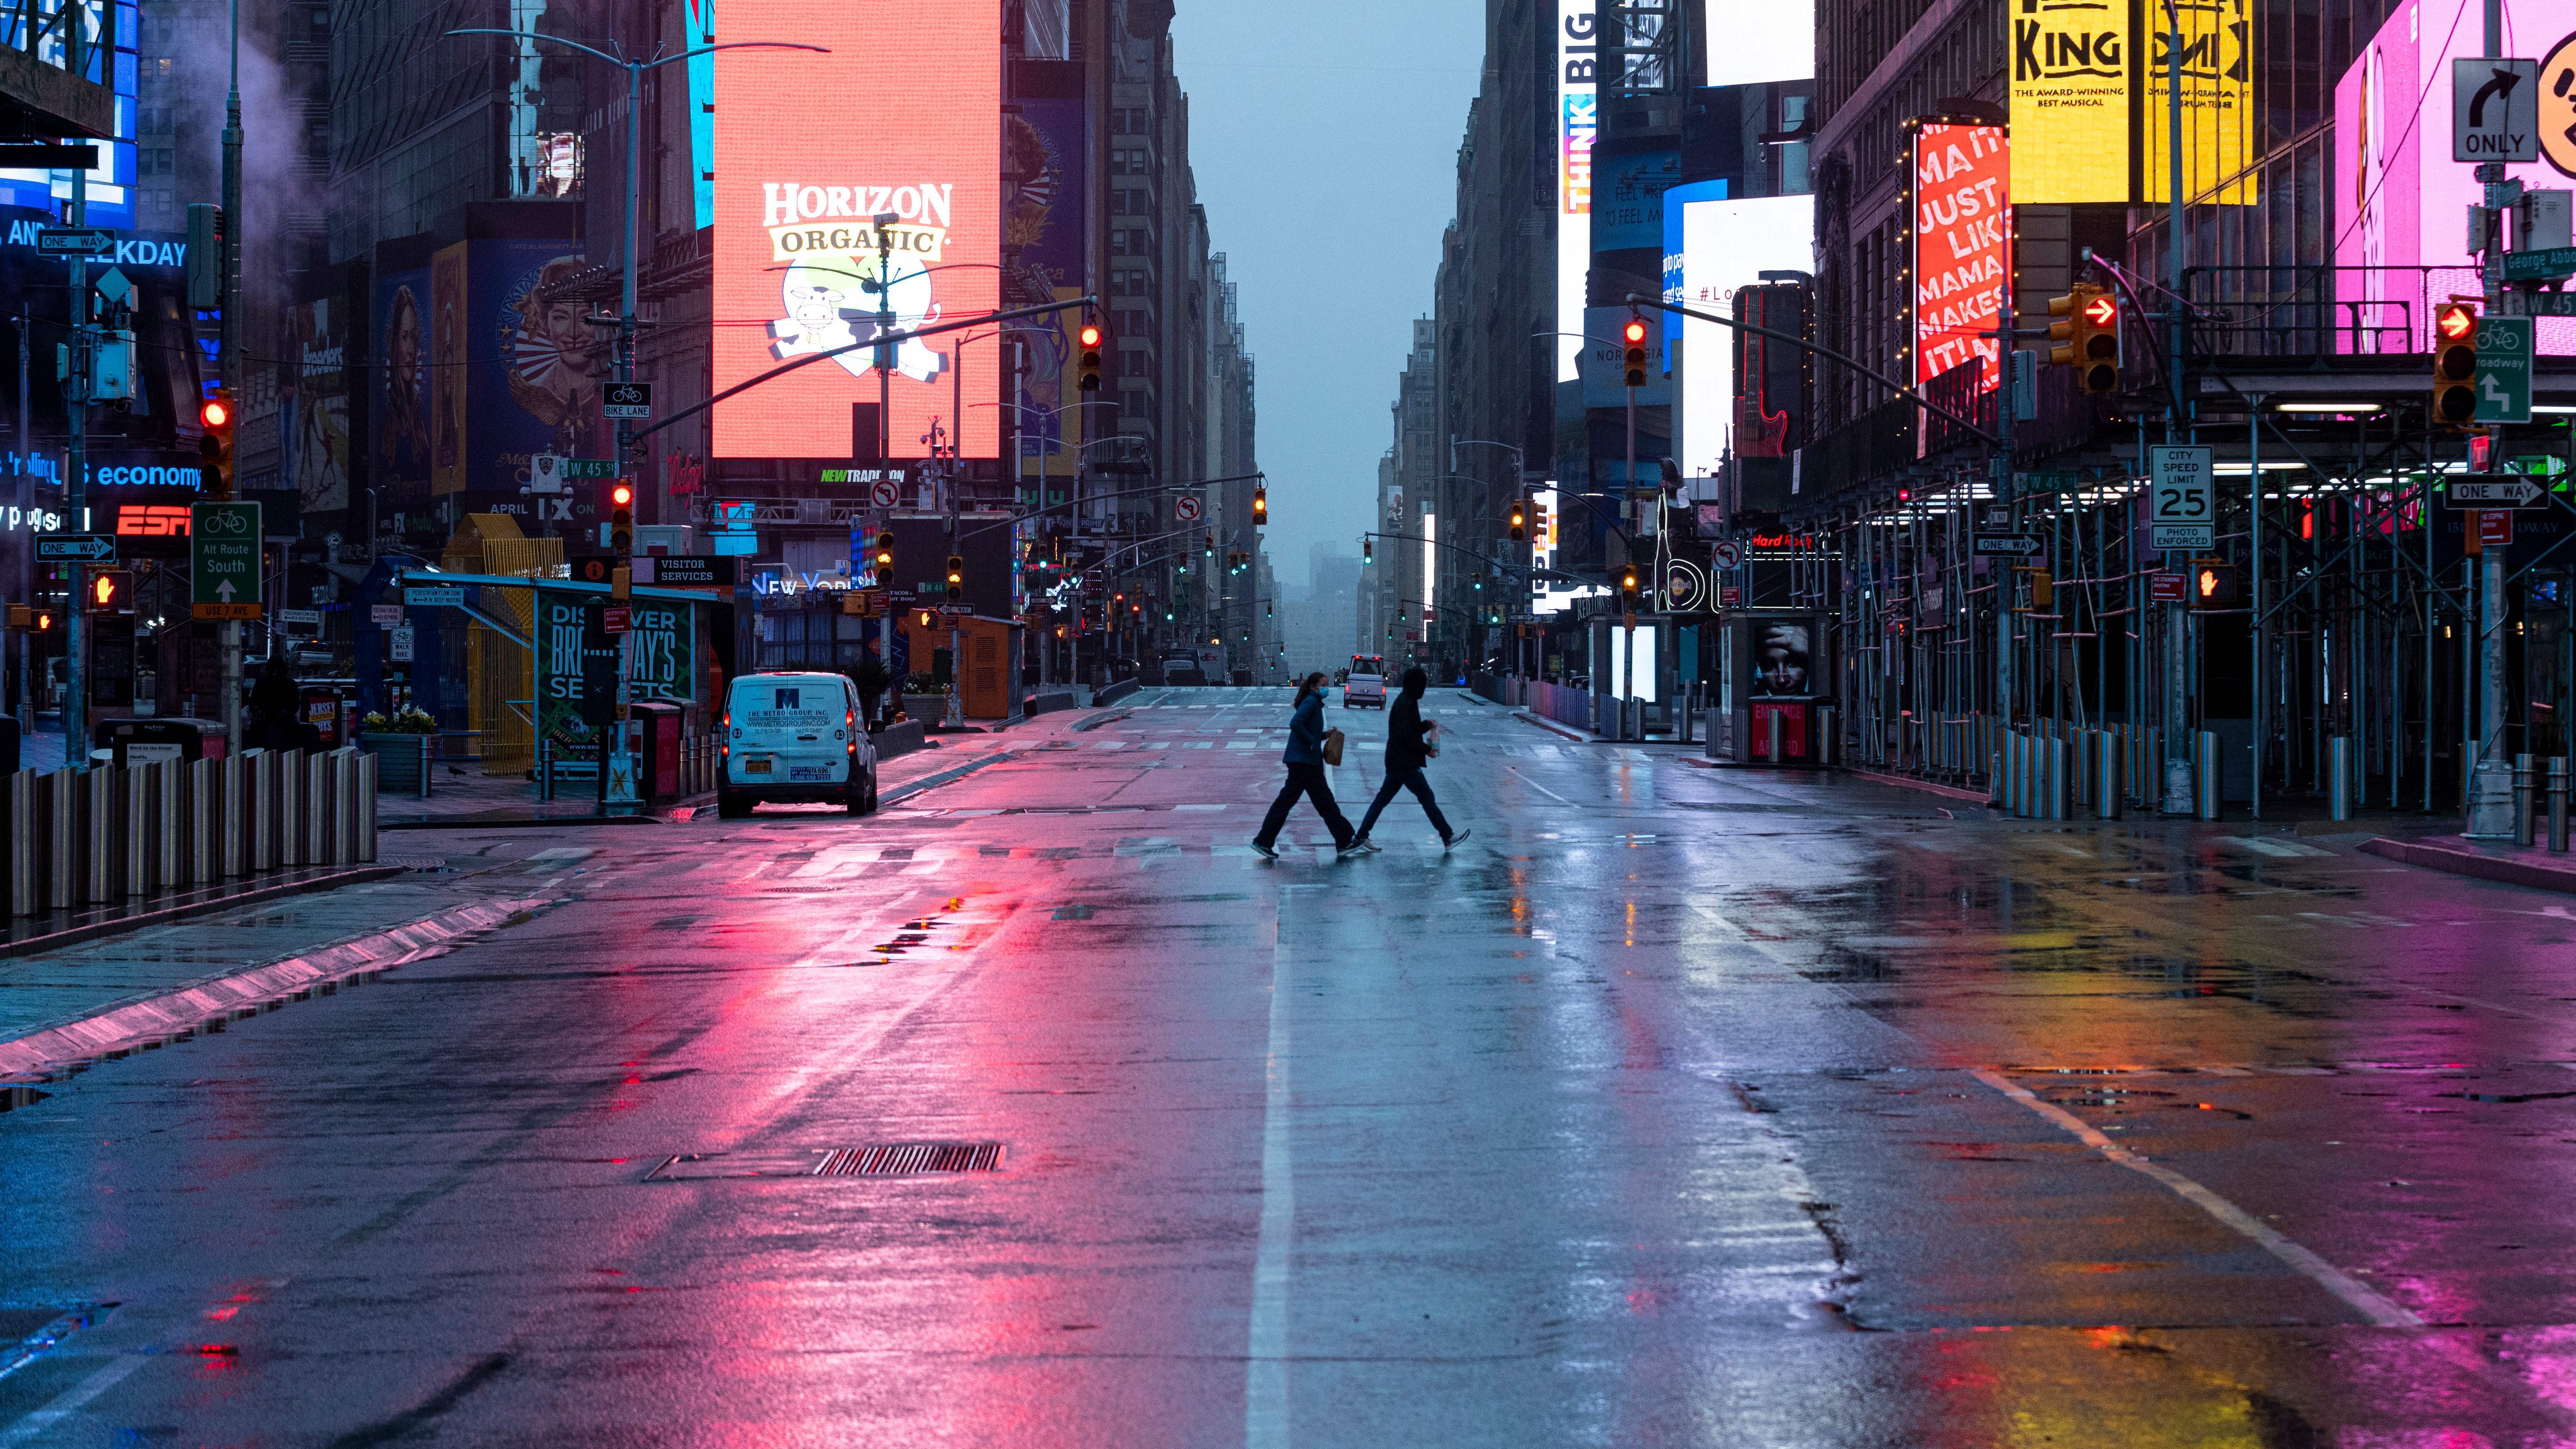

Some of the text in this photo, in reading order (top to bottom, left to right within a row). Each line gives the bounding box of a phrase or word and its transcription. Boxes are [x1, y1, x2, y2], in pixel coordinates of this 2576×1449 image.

[2015, 18, 2121, 82] KING
[2036, 88, 2123, 96] AWARD-WINNING
[1549, 53, 1557, 175] SQUARE
[1565, 13, 1596, 210] THINK BIG
[2466, 134, 2524, 153] ONLY
[1616, 187, 1638, 201] FEEL
[763, 183, 953, 227] HORIZON
[1919, 177, 1997, 234] JUST
[1605, 212, 1615, 226] TO
[1620, 208, 1642, 224] FEEL
[45, 237, 104, 247] ONE WAY
[2508, 255, 2546, 270] George
[1919, 255, 2003, 306] MAMA
[2530, 295, 2572, 314] W 45
[606, 407, 648, 415] BIKE LANE
[2169, 451, 2193, 460] CITY
[571, 463, 614, 477] W 45 St
[2163, 464, 2198, 472] SPEED
[2031, 476, 2041, 489] W
[2046, 477, 2060, 489] 45
[2167, 475, 2195, 484] LIMIT
[2460, 485, 2533, 498] ONE WAY
[2160, 489, 2205, 516] 25
[491, 504, 594, 515] APRIL ON
[43, 544, 103, 553] ONE WAY
[203, 544, 249, 554] Alt Route
[1983, 540, 2033, 549] ONE WAY
[207, 559, 245, 573] South
[661, 560, 705, 569] VISITOR
[661, 572, 713, 581] SERVICES
[206, 606, 248, 615] USE 7 AVE
[309, 701, 336, 715] JERSEY
